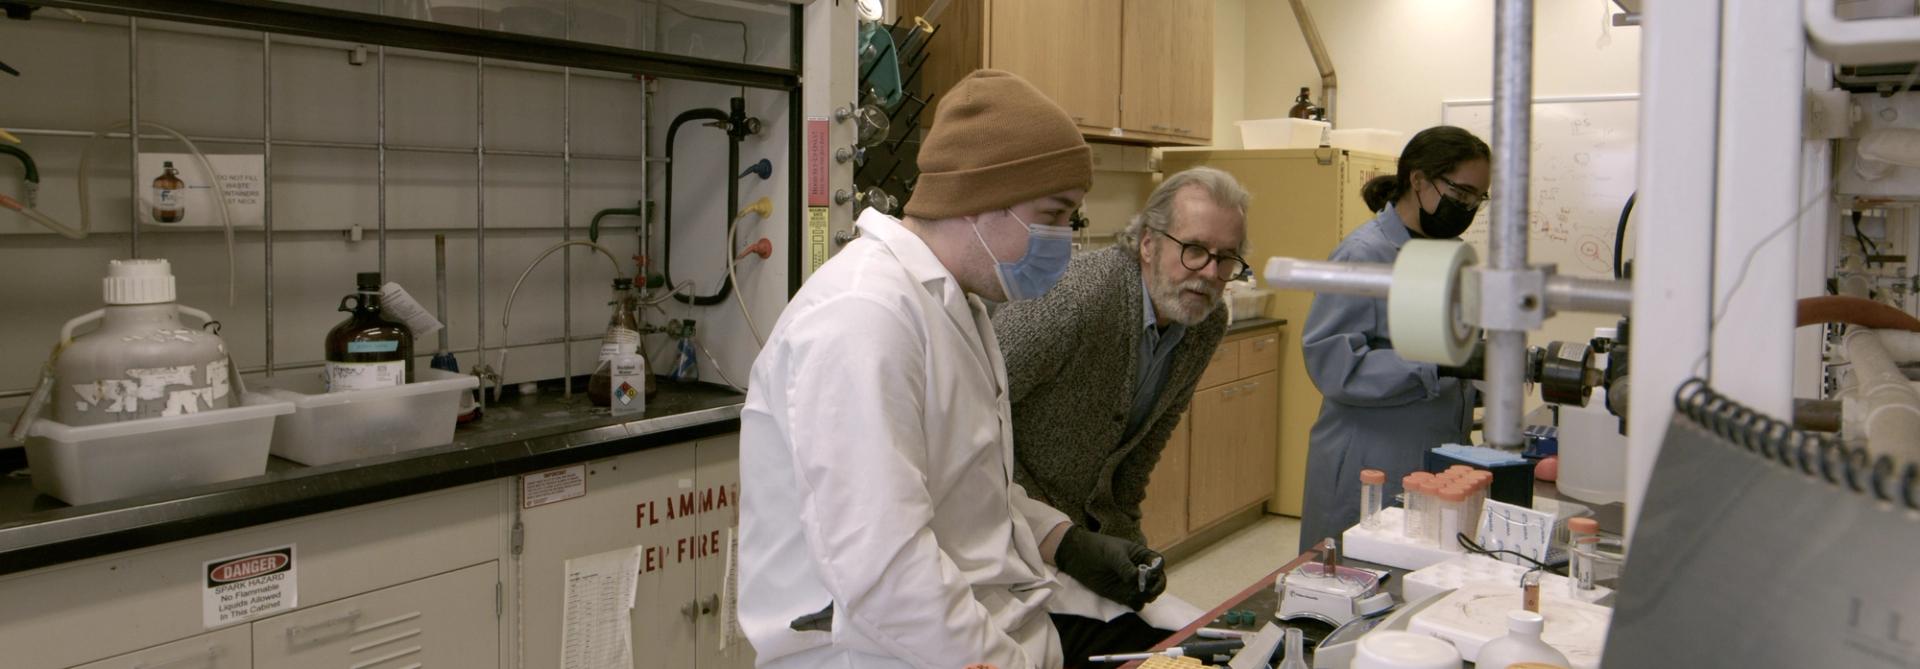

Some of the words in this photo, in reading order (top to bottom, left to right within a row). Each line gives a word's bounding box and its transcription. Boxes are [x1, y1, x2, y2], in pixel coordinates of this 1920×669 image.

[678, 530, 719, 563] FIRE
[223, 556, 277, 579] DANGER
[215, 581, 246, 595] SPARK
[248, 573, 285, 587] HAZARD
[221, 594, 233, 602] No
[235, 584, 279, 599] Flammable
[219, 600, 248, 612] Liquids
[250, 591, 281, 603] Allowed
[220, 613, 228, 621] In
[231, 608, 248, 617] This
[249, 600, 281, 613] Cabinet
